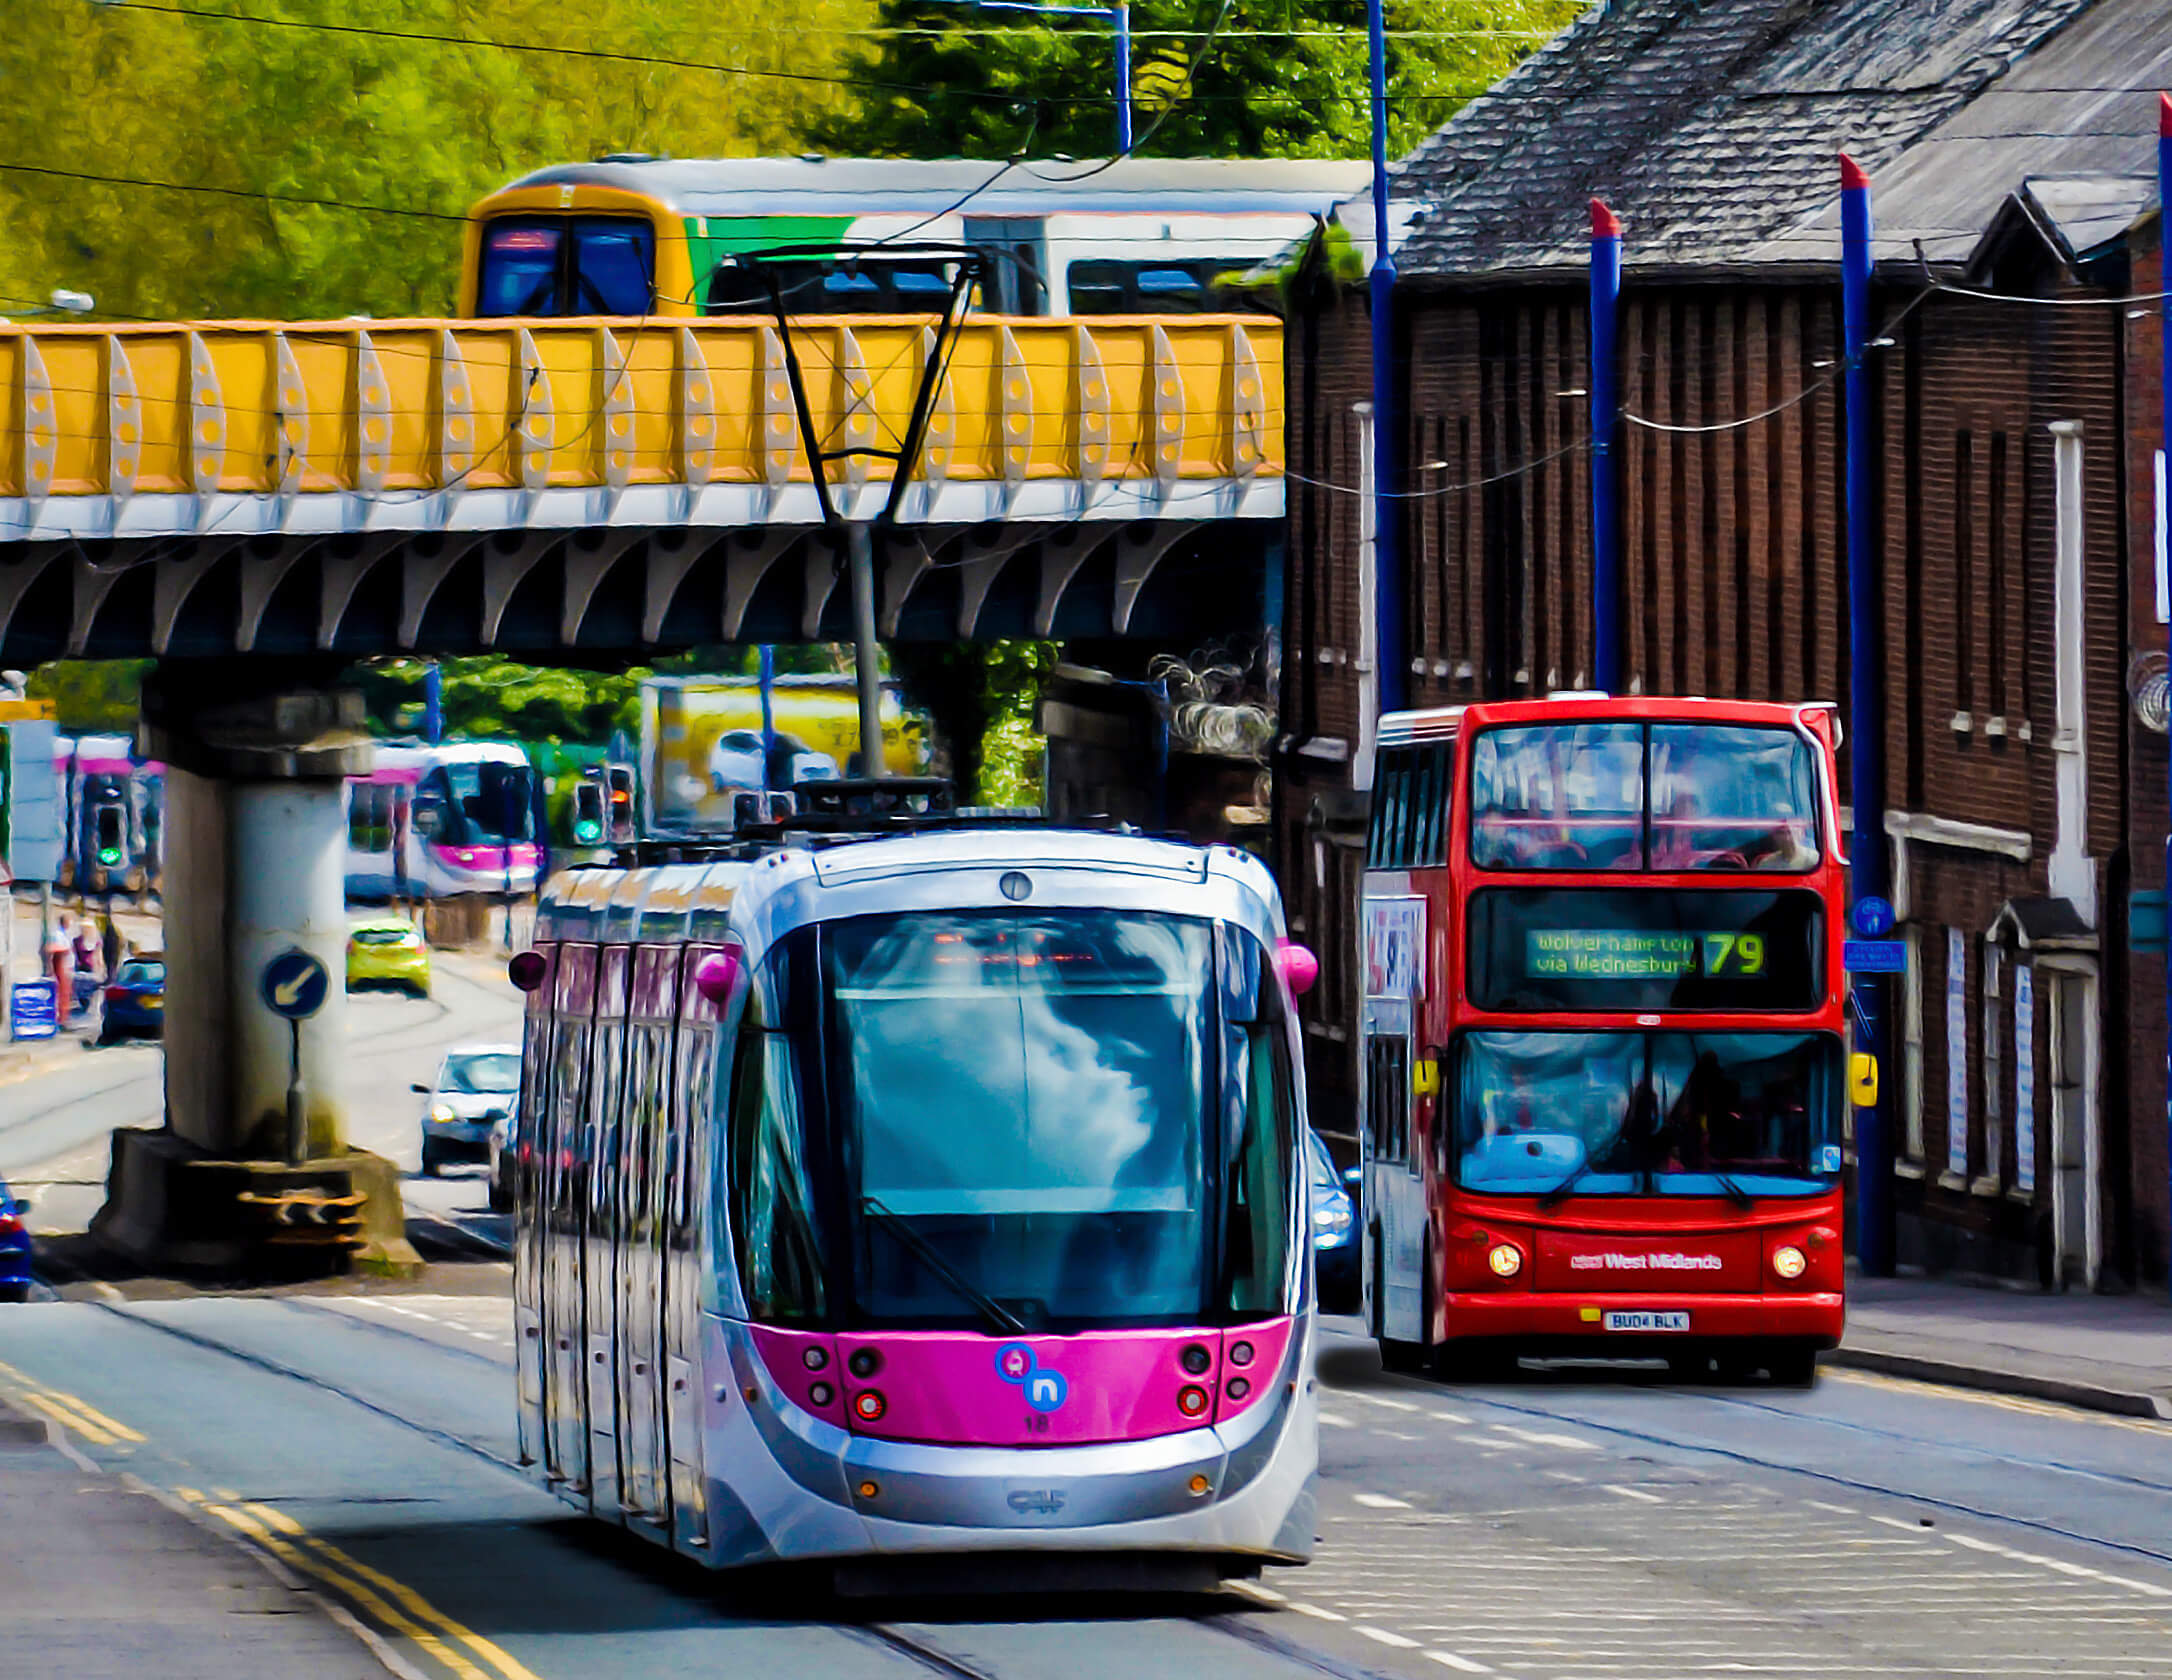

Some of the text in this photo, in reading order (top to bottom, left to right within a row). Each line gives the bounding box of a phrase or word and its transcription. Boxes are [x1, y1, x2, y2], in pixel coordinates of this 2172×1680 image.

[1707, 934, 1764, 973] 79
[1537, 956, 1567, 972] via
[1604, 1253, 1646, 1269] West
[1649, 1253, 1722, 1269] Midlands
[1654, 1316, 1683, 1328] BLK
[1033, 1379, 1058, 1402] n
[1024, 1415, 1049, 1433] 18
